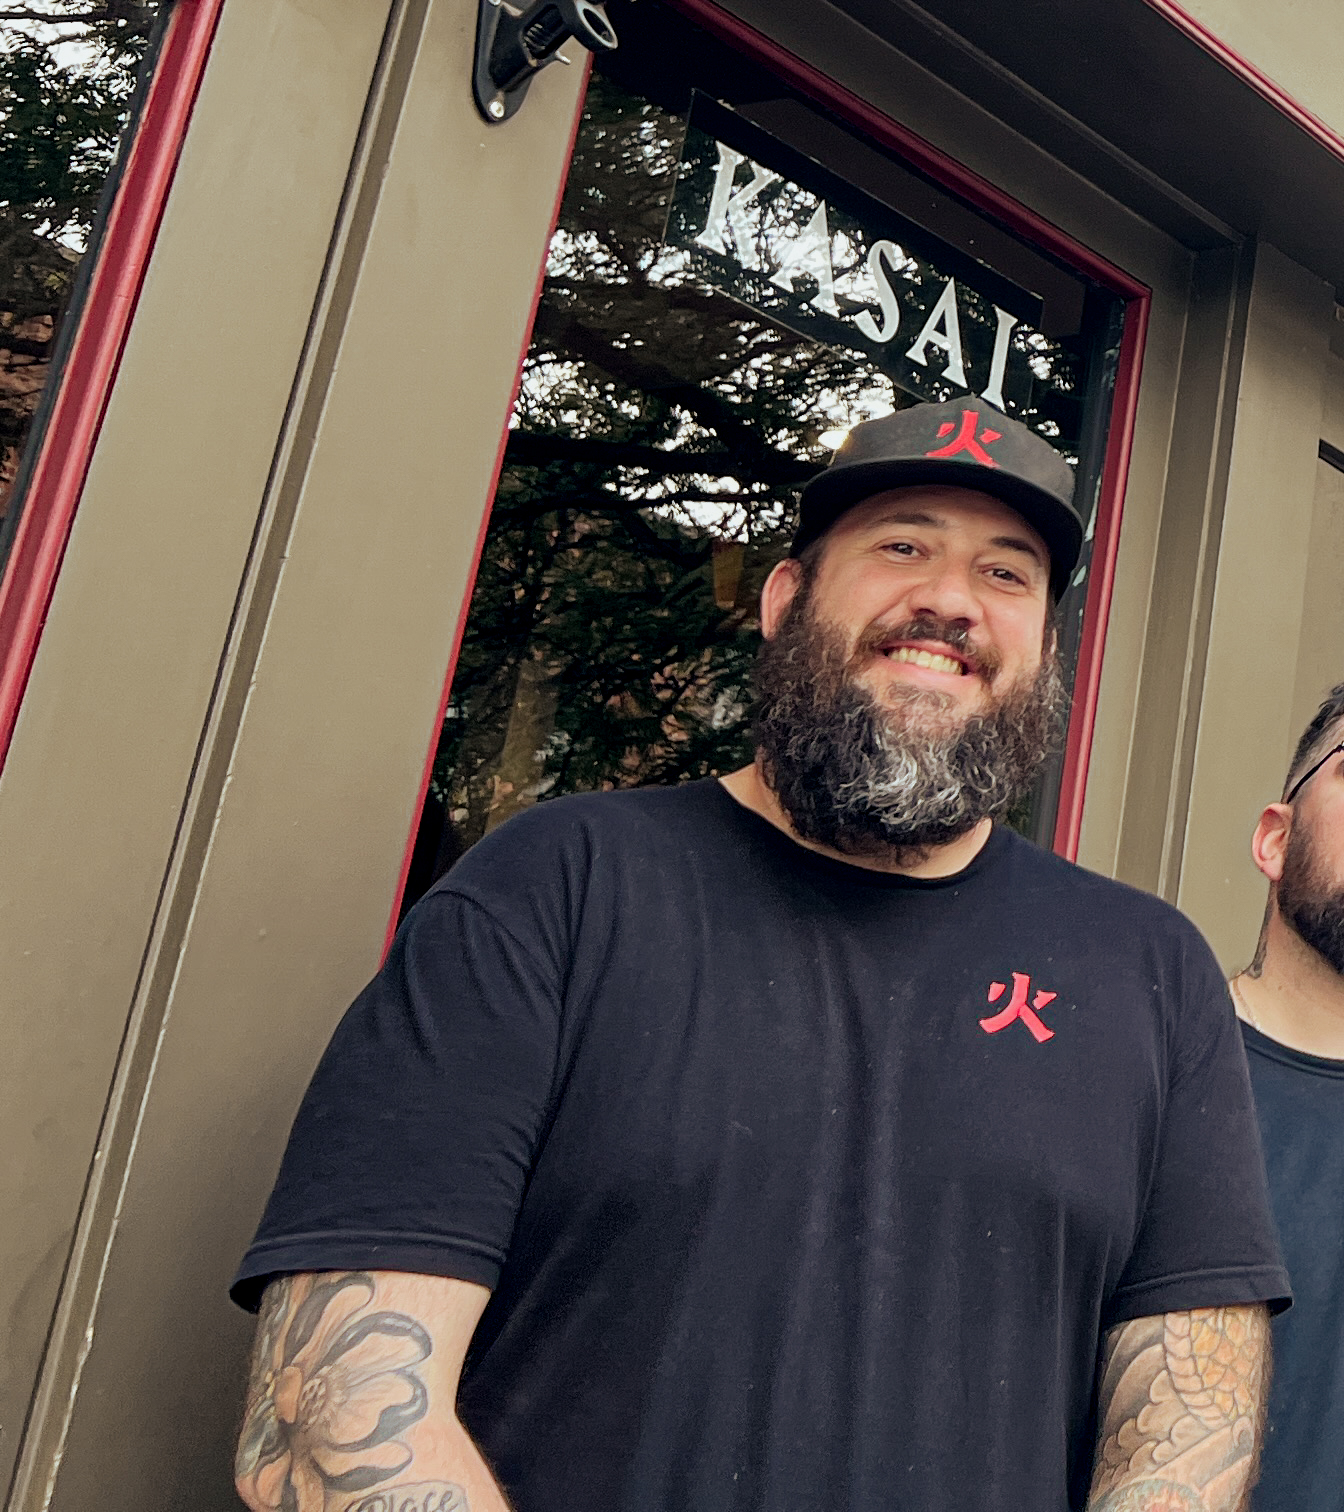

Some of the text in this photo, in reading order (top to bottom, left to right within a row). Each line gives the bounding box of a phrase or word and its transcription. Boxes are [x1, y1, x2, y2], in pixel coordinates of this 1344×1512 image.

[695, 142, 1020, 411] KASAI
[925, 409, 1004, 468] 火
[978, 972, 1058, 1044] 火
